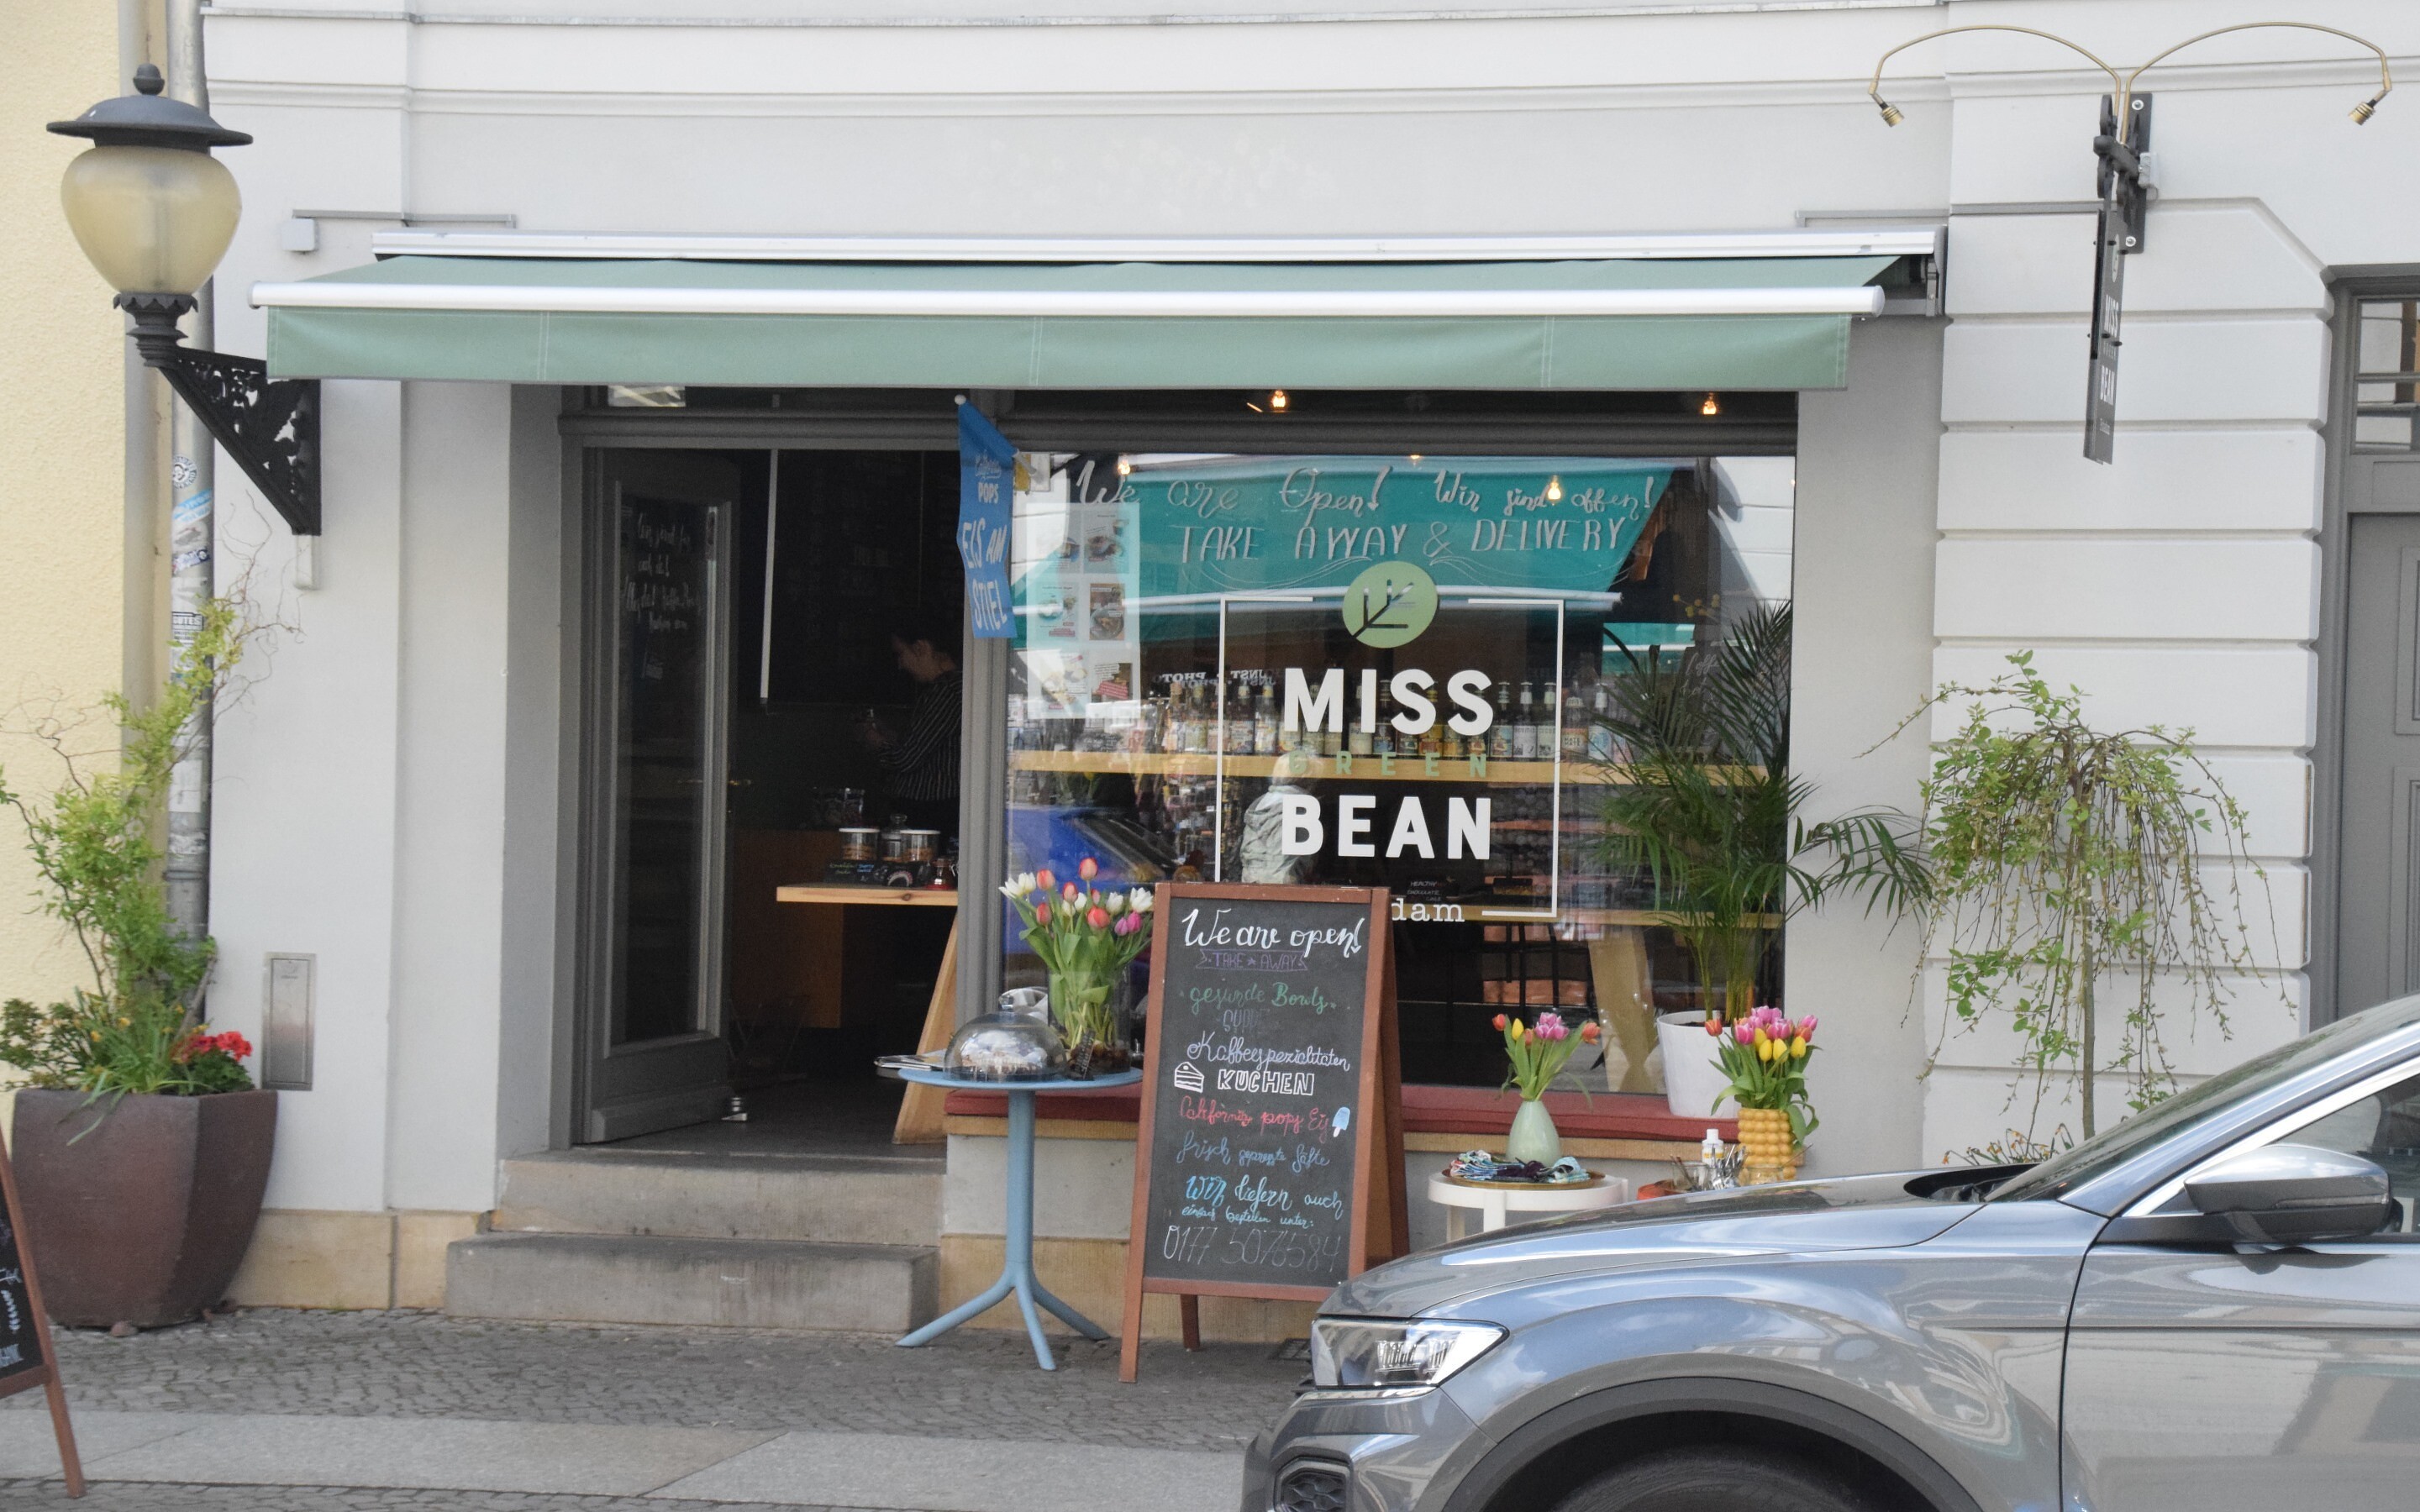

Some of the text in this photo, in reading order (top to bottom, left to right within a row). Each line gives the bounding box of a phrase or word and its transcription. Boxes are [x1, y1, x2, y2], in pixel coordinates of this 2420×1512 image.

[978, 482, 999, 503] POPS
[1076, 460, 1140, 506] We
[1168, 480, 1240, 518] are
[1434, 468, 1481, 512] Wir
[962, 517, 1007, 569] EIS AM
[1168, 516, 1626, 564] TAKE AWAY & DELIVERY
[972, 579, 1007, 631] STIEL
[1285, 668, 1494, 736] MISS
[1289, 750, 1486, 778] GREEN
[1281, 794, 1491, 860] BEAN
[1391, 898, 1465, 922] dam
[1181, 908, 1365, 958] We are open!
[1213, 952, 1297, 967] TAKE AWAY
[1218, 1068, 1315, 1095] KUCHEN
[1176, 1130, 1231, 1165] frisch
[1186, 1174, 1227, 1207] Wir
[1304, 1191, 1344, 1221] auch
[1280, 1212, 1314, 1230] unter:
[1163, 1225, 1218, 1265] 0177
